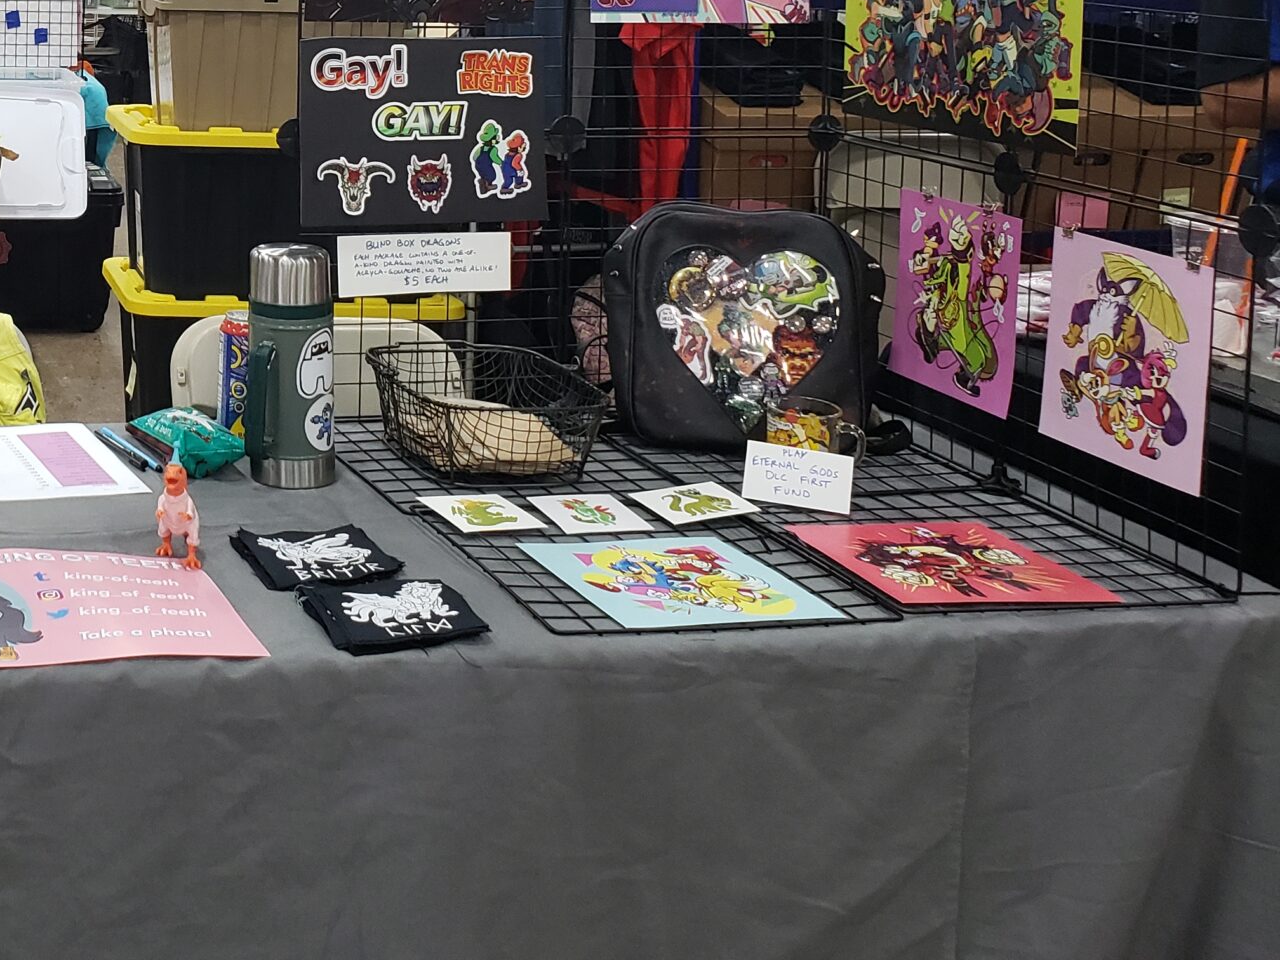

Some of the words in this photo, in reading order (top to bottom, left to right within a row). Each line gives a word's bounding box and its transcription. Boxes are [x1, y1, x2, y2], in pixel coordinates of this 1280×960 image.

[463, 51, 531, 74] TRANS
[315, 49, 405, 94] Gay!
[459, 72, 531, 94] RIGHTS
[377, 104, 466, 137] GAY!
[366, 240, 391, 250] BLIND
[397, 239, 415, 247] BOX
[421, 238, 461, 247] DRAGONS
[404, 276, 419, 286] $5
[425, 275, 448, 284] EACH
[782, 448, 807, 459] PLAY
[752, 456, 800, 470] ETERNAL
[809, 465, 838, 479] GODS
[766, 470, 788, 481] DLC
[800, 476, 831, 488] FIRST
[774, 486, 810, 498] FUND
[61, 553, 99, 563] OF
[64, 571, 179, 587] king-of-teeth
[79, 628, 124, 641] Take
[131, 629, 143, 637] a
[150, 627, 212, 638] photo!
